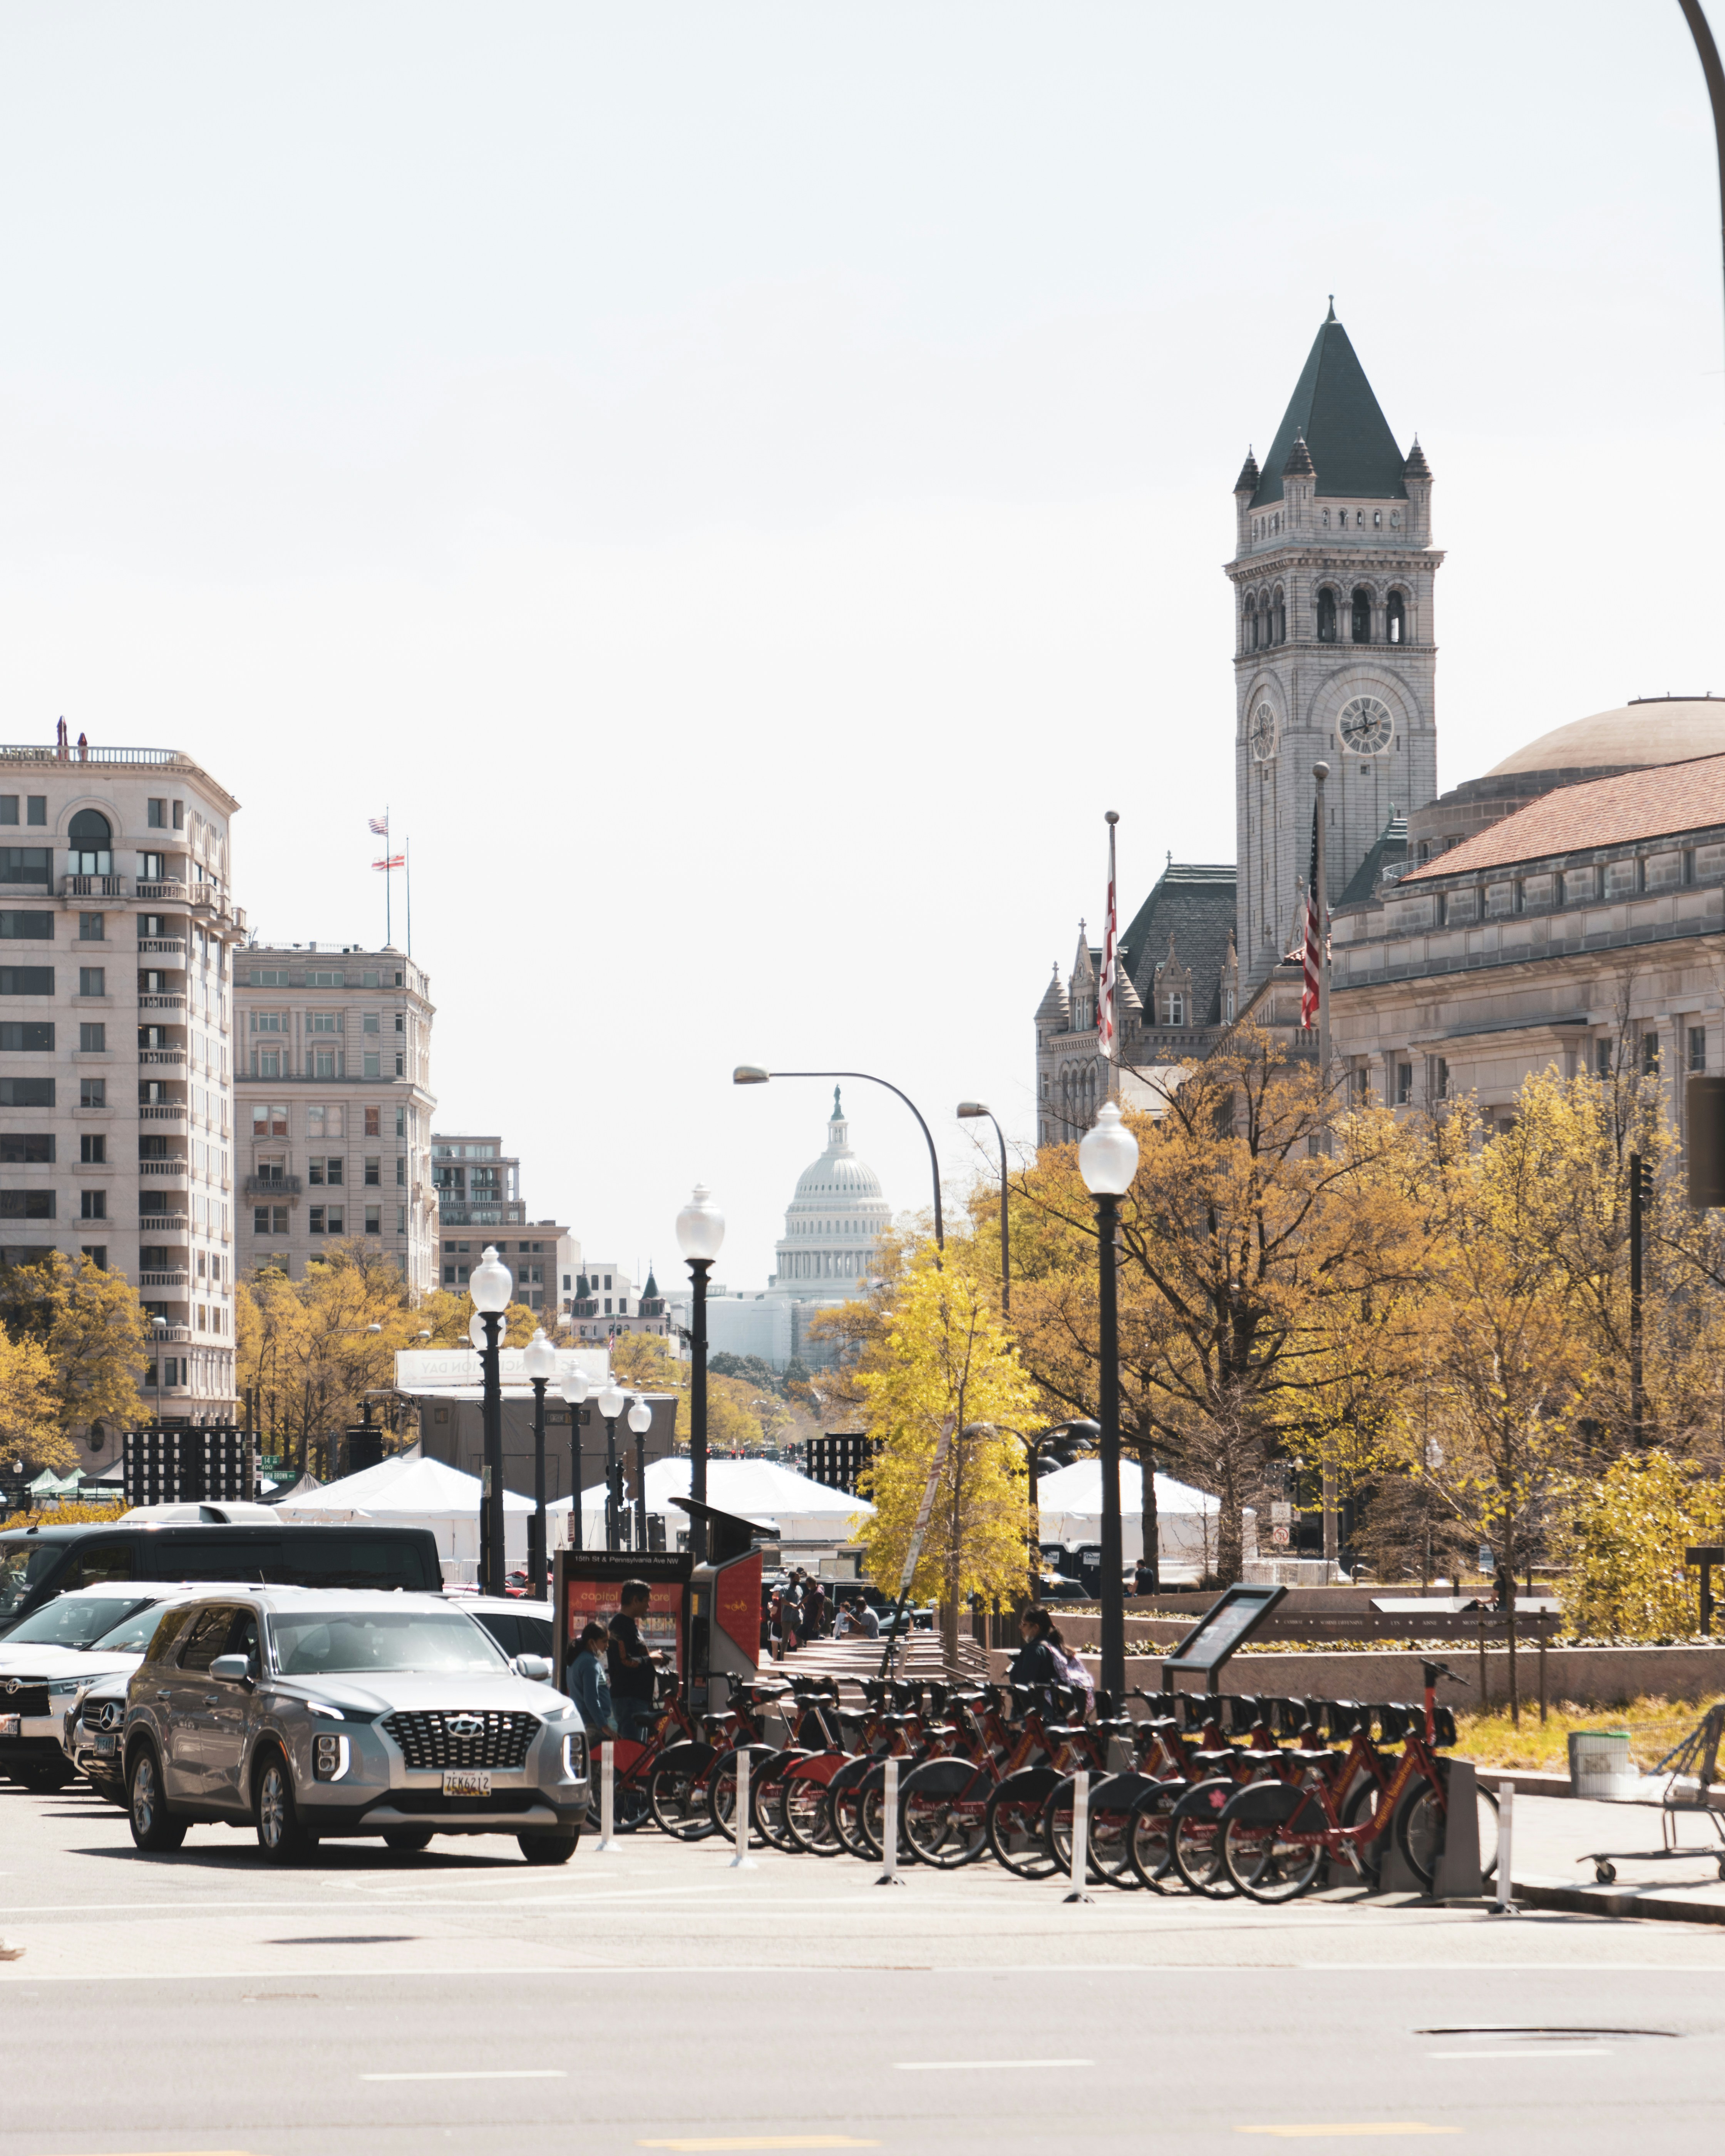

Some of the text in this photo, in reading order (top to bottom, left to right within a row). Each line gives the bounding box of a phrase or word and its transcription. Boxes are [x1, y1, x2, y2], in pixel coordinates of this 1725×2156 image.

[581, 1592, 618, 1602] capital
[1011, 1734, 1034, 1769] bikeshare
[1334, 1754, 1360, 1794] bikeshare
[1374, 1756, 1415, 1829] capital bikeshare
